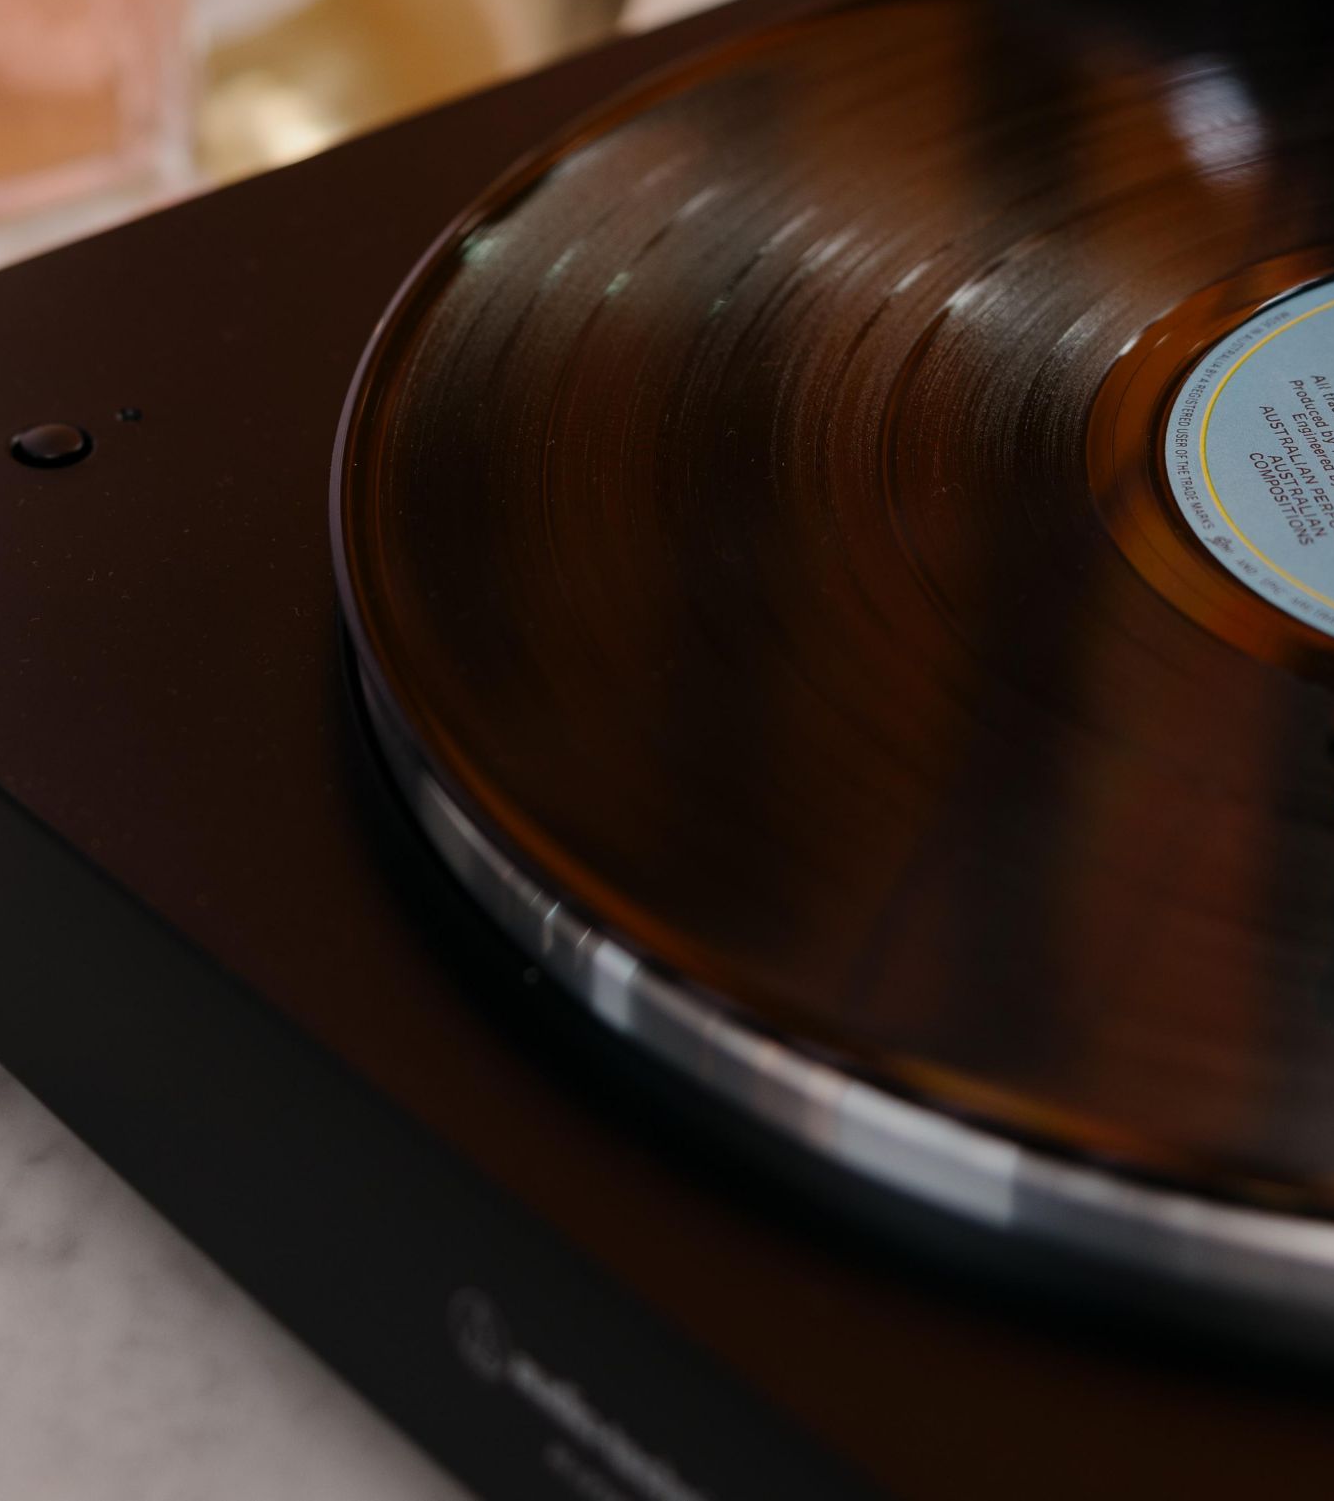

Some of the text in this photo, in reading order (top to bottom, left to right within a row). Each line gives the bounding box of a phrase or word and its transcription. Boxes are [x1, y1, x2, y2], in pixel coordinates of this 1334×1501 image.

[1209, 332, 1256, 369] AUSTRALIA
[1200, 367, 1219, 379] BY
[1311, 376, 1331, 389] All
[1176, 382, 1207, 427] REGISTERED
[1290, 380, 1329, 428] Produced
[1174, 428, 1188, 448] USER
[1259, 406, 1318, 484] AUSTRALIAN
[1174, 449, 1188, 459] OF
[1175, 460, 1190, 475] THE
[1177, 476, 1199, 501] TRADE
[1250, 453, 1313, 545] COMPOSITIONS
[1267, 456, 1326, 536] AUSTRALIAN
[1187, 501, 1217, 530] MARKS
